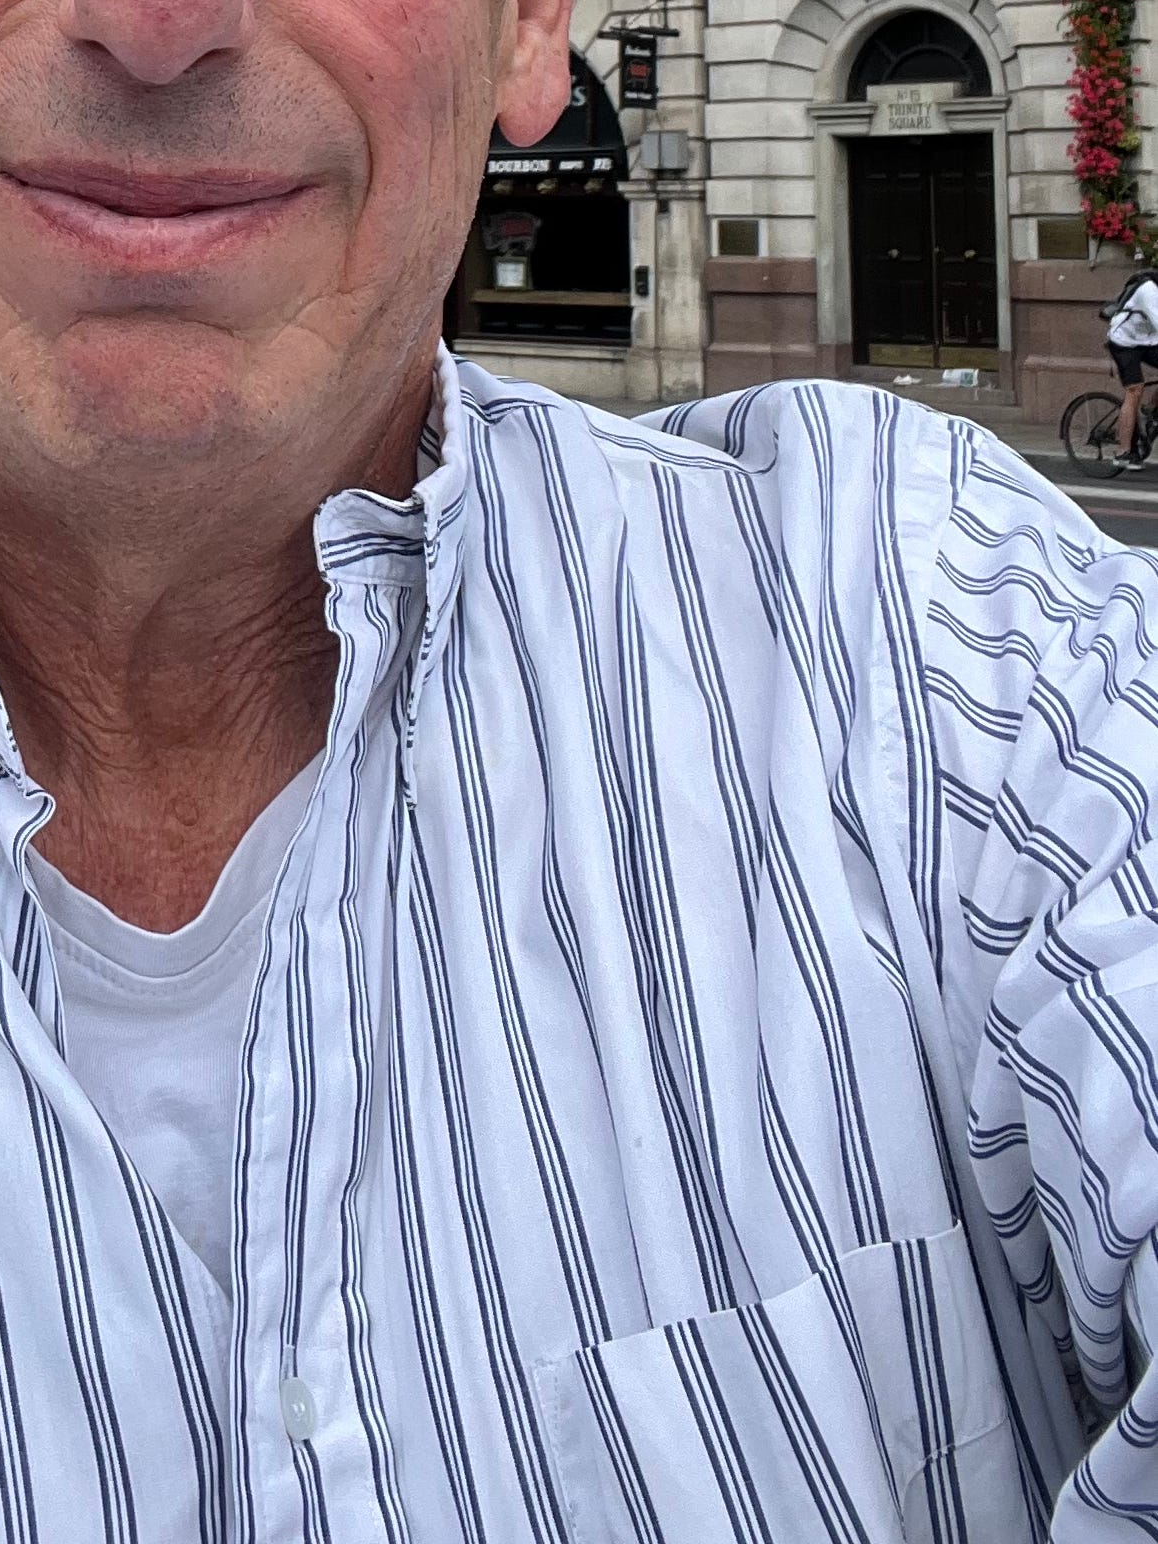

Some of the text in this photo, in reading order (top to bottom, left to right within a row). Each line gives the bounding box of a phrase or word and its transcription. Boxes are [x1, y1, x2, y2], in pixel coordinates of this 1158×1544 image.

[887, 103, 932, 117] TRINITY
[887, 117, 933, 130] SQUARE
[487, 159, 551, 173] BOURBON
